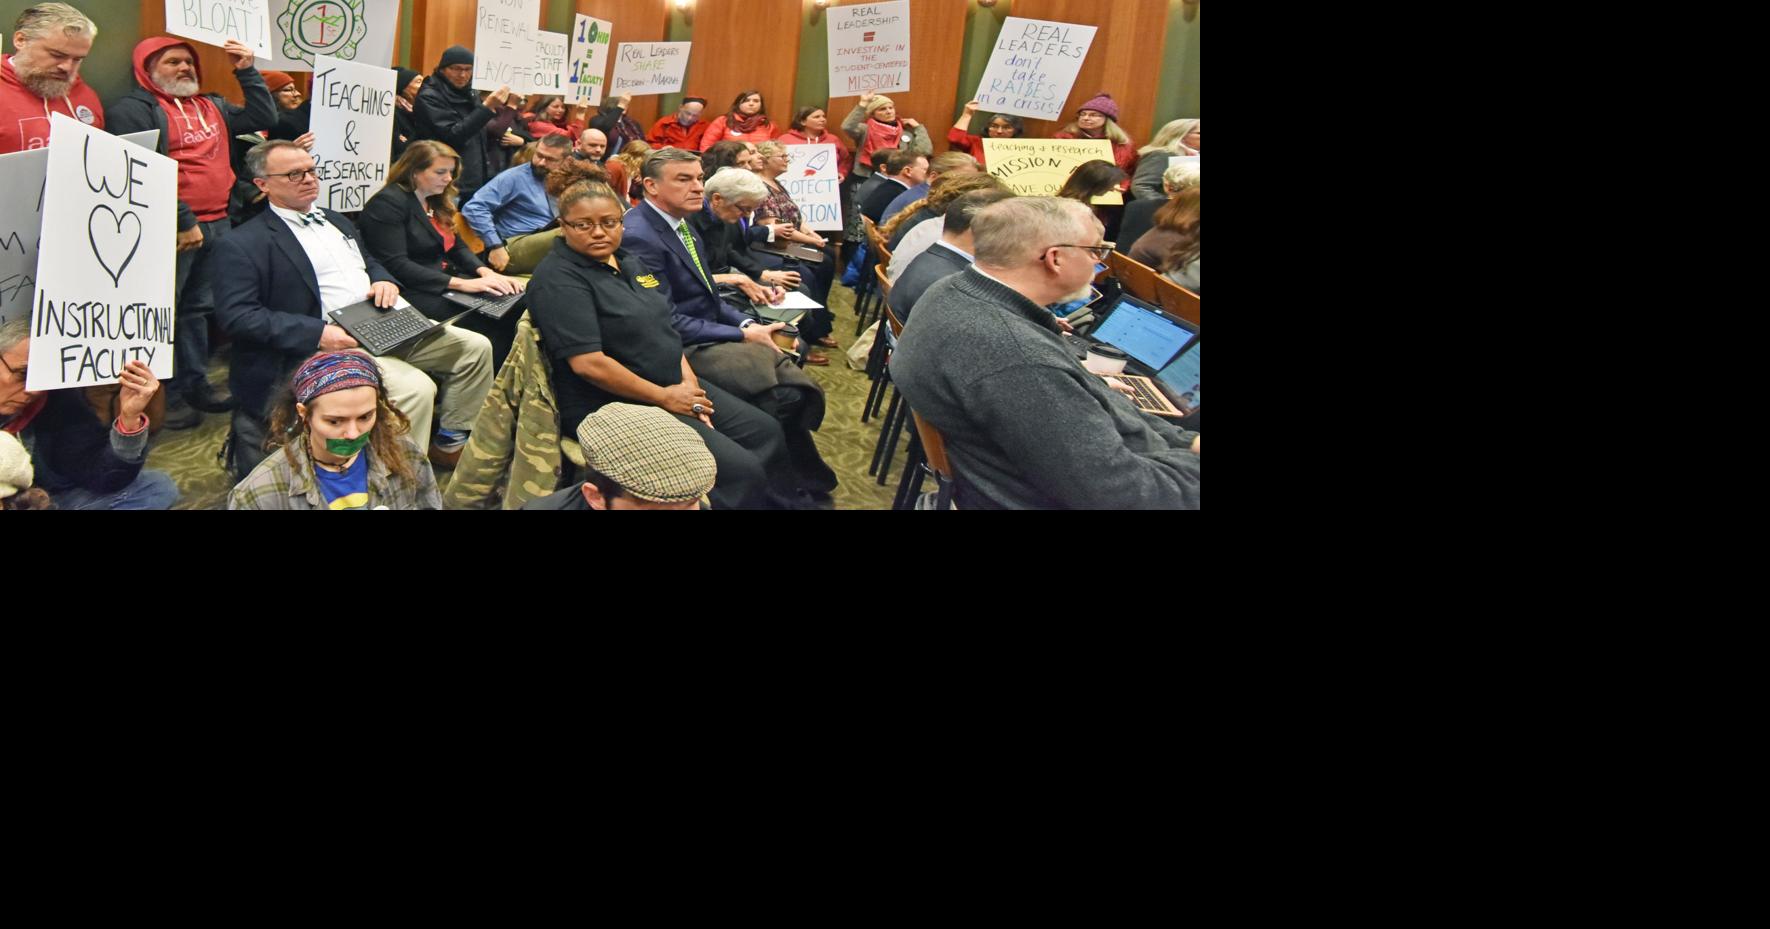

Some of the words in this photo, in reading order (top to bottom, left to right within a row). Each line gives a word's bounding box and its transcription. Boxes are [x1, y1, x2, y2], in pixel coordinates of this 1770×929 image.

[852, 6, 881, 17] REAL
[837, 16, 900, 31] LEADERSHIP
[1021, 23, 1072, 44] REAL
[998, 39, 1083, 58] LEADERS
[848, 71, 902, 92] MISSION!
[1012, 68, 1046, 81] take
[316, 67, 393, 117] TEACHING
[343, 120, 360, 155] &
[991, 142, 1035, 155] teaching
[1051, 144, 1103, 156] research
[83, 134, 149, 208] WE
[991, 157, 1061, 178] MISSION
[329, 182, 370, 211] FIRST
[781, 178, 836, 195] OTECT
[800, 203, 837, 223] SION
[36, 289, 175, 345] INSTRUCTIONAL
